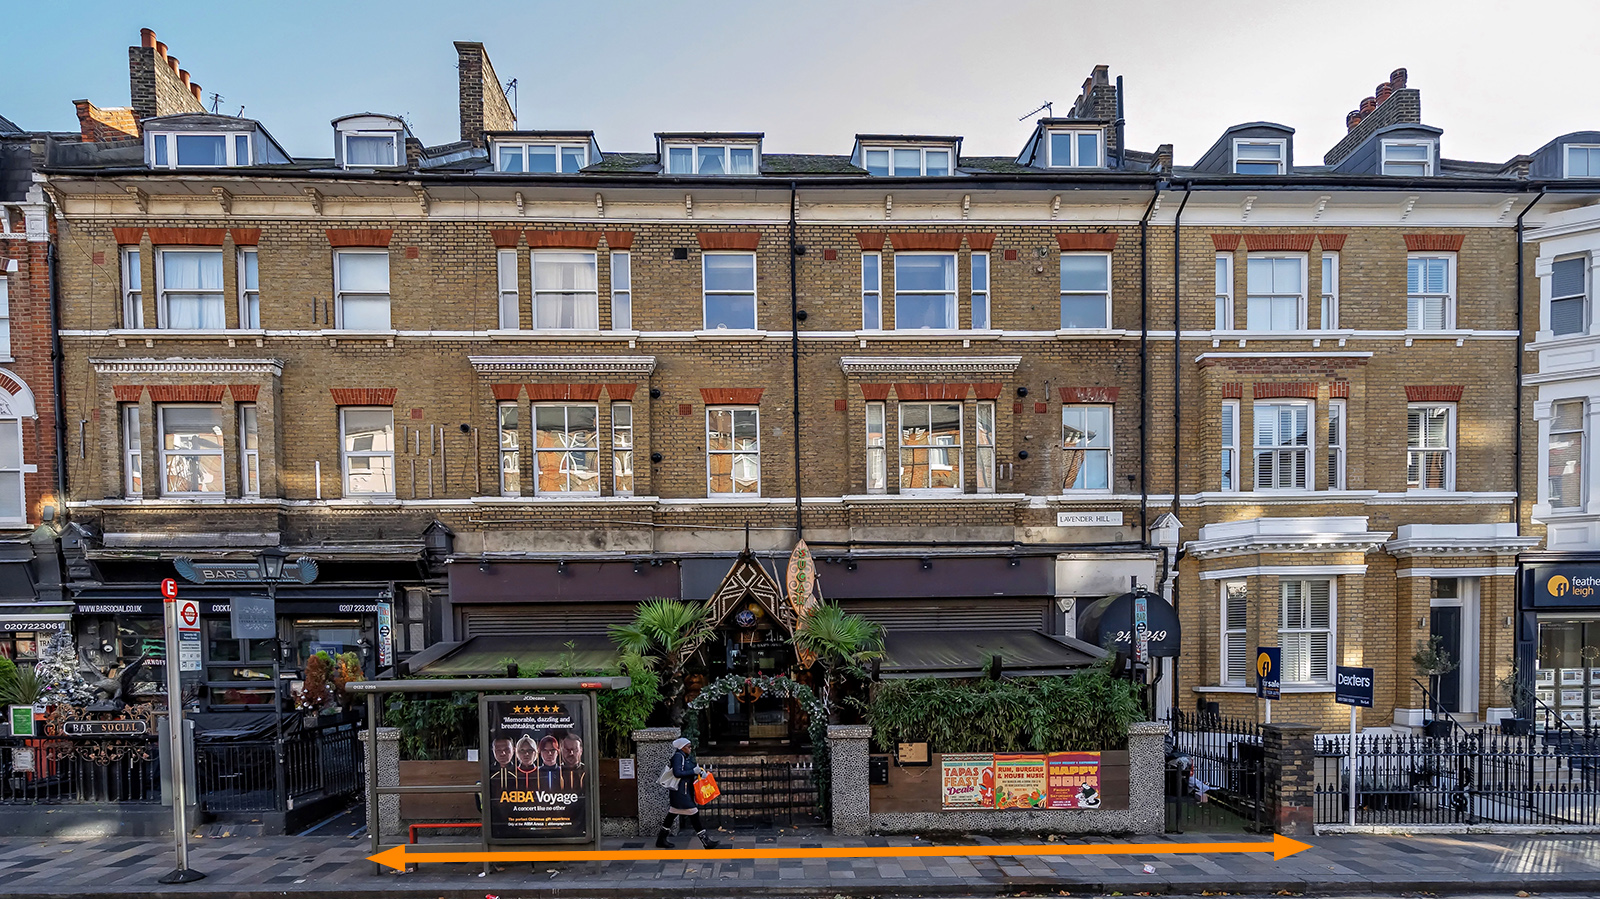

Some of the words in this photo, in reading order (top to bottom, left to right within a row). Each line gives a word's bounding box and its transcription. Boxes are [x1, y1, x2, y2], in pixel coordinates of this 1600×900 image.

[797, 549, 807, 605] SUGAR
[167, 581, 175, 595] E
[1572, 586, 1594, 598] leigh
[1268, 679, 1280, 688] sale
[1338, 673, 1371, 687] Dexters
[73, 724, 92, 732] BAR
[101, 724, 138, 732] SOCIAL
[944, 767, 979, 776] TAPAS
[1049, 766, 1098, 775] HAPPY
[944, 777, 978, 787] FEAST
[1049, 776, 1098, 787] HOUR
[947, 785, 975, 795] Deals
[500, 791, 534, 803] ABBA
[536, 791, 578, 804] Voyage
